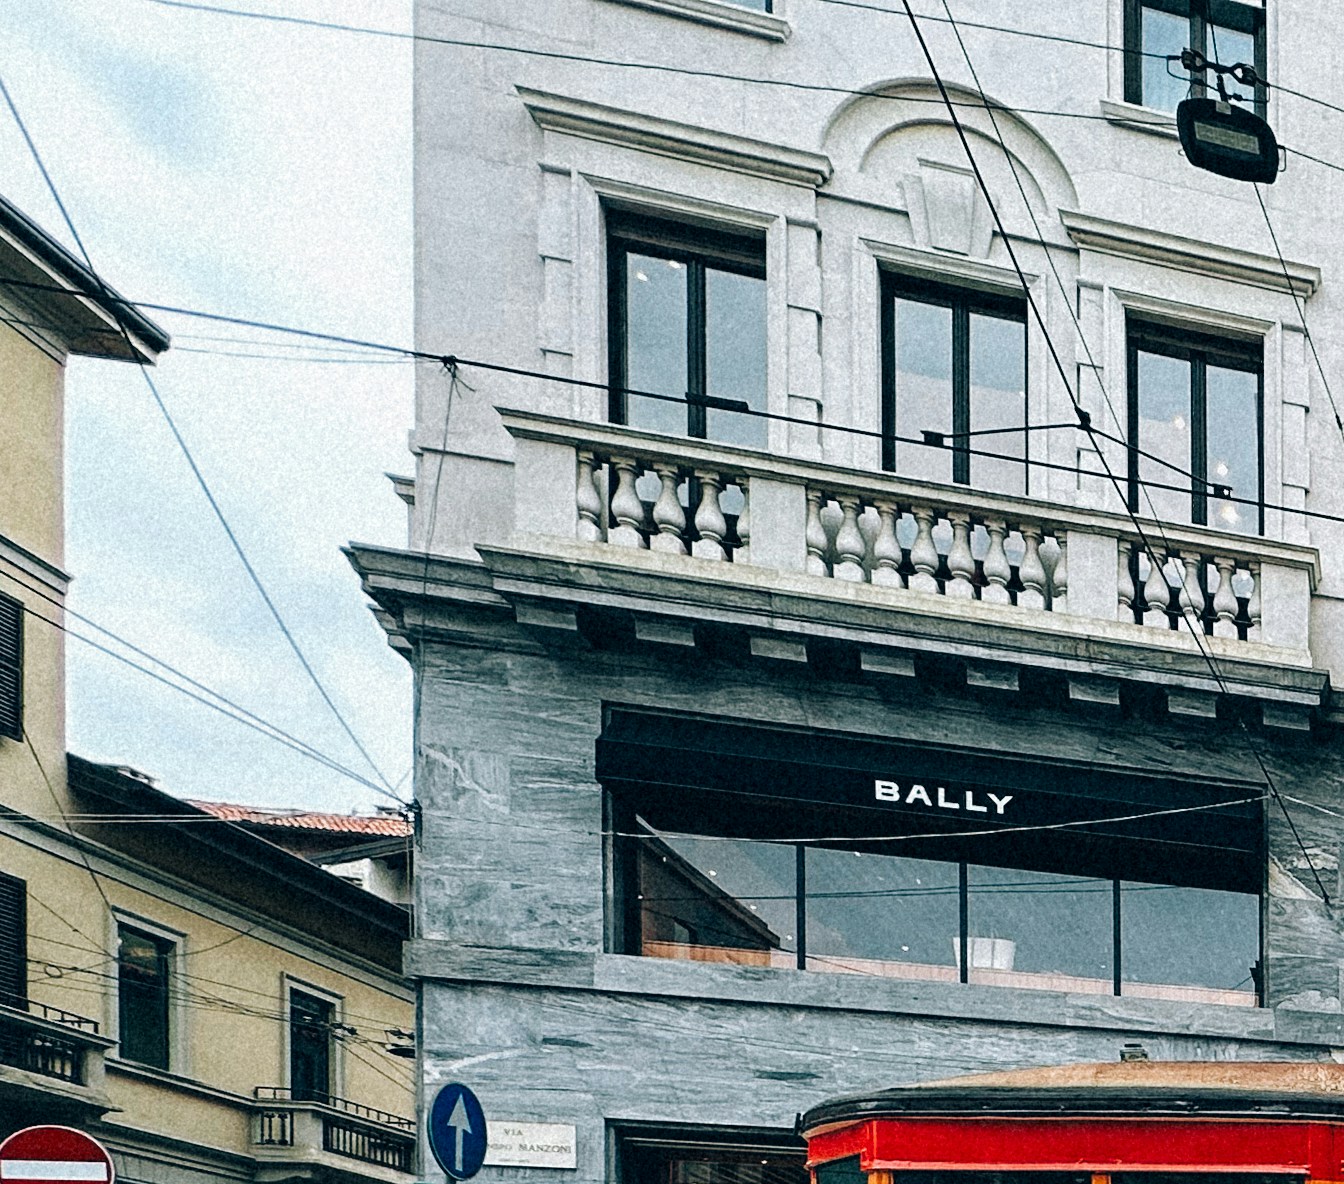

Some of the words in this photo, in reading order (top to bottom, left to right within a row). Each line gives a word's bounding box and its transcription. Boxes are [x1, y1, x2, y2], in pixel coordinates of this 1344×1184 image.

[874, 779, 1014, 815] BALLY
[503, 1128, 524, 1136] VIA
[519, 1143, 572, 1154] MANZONI
